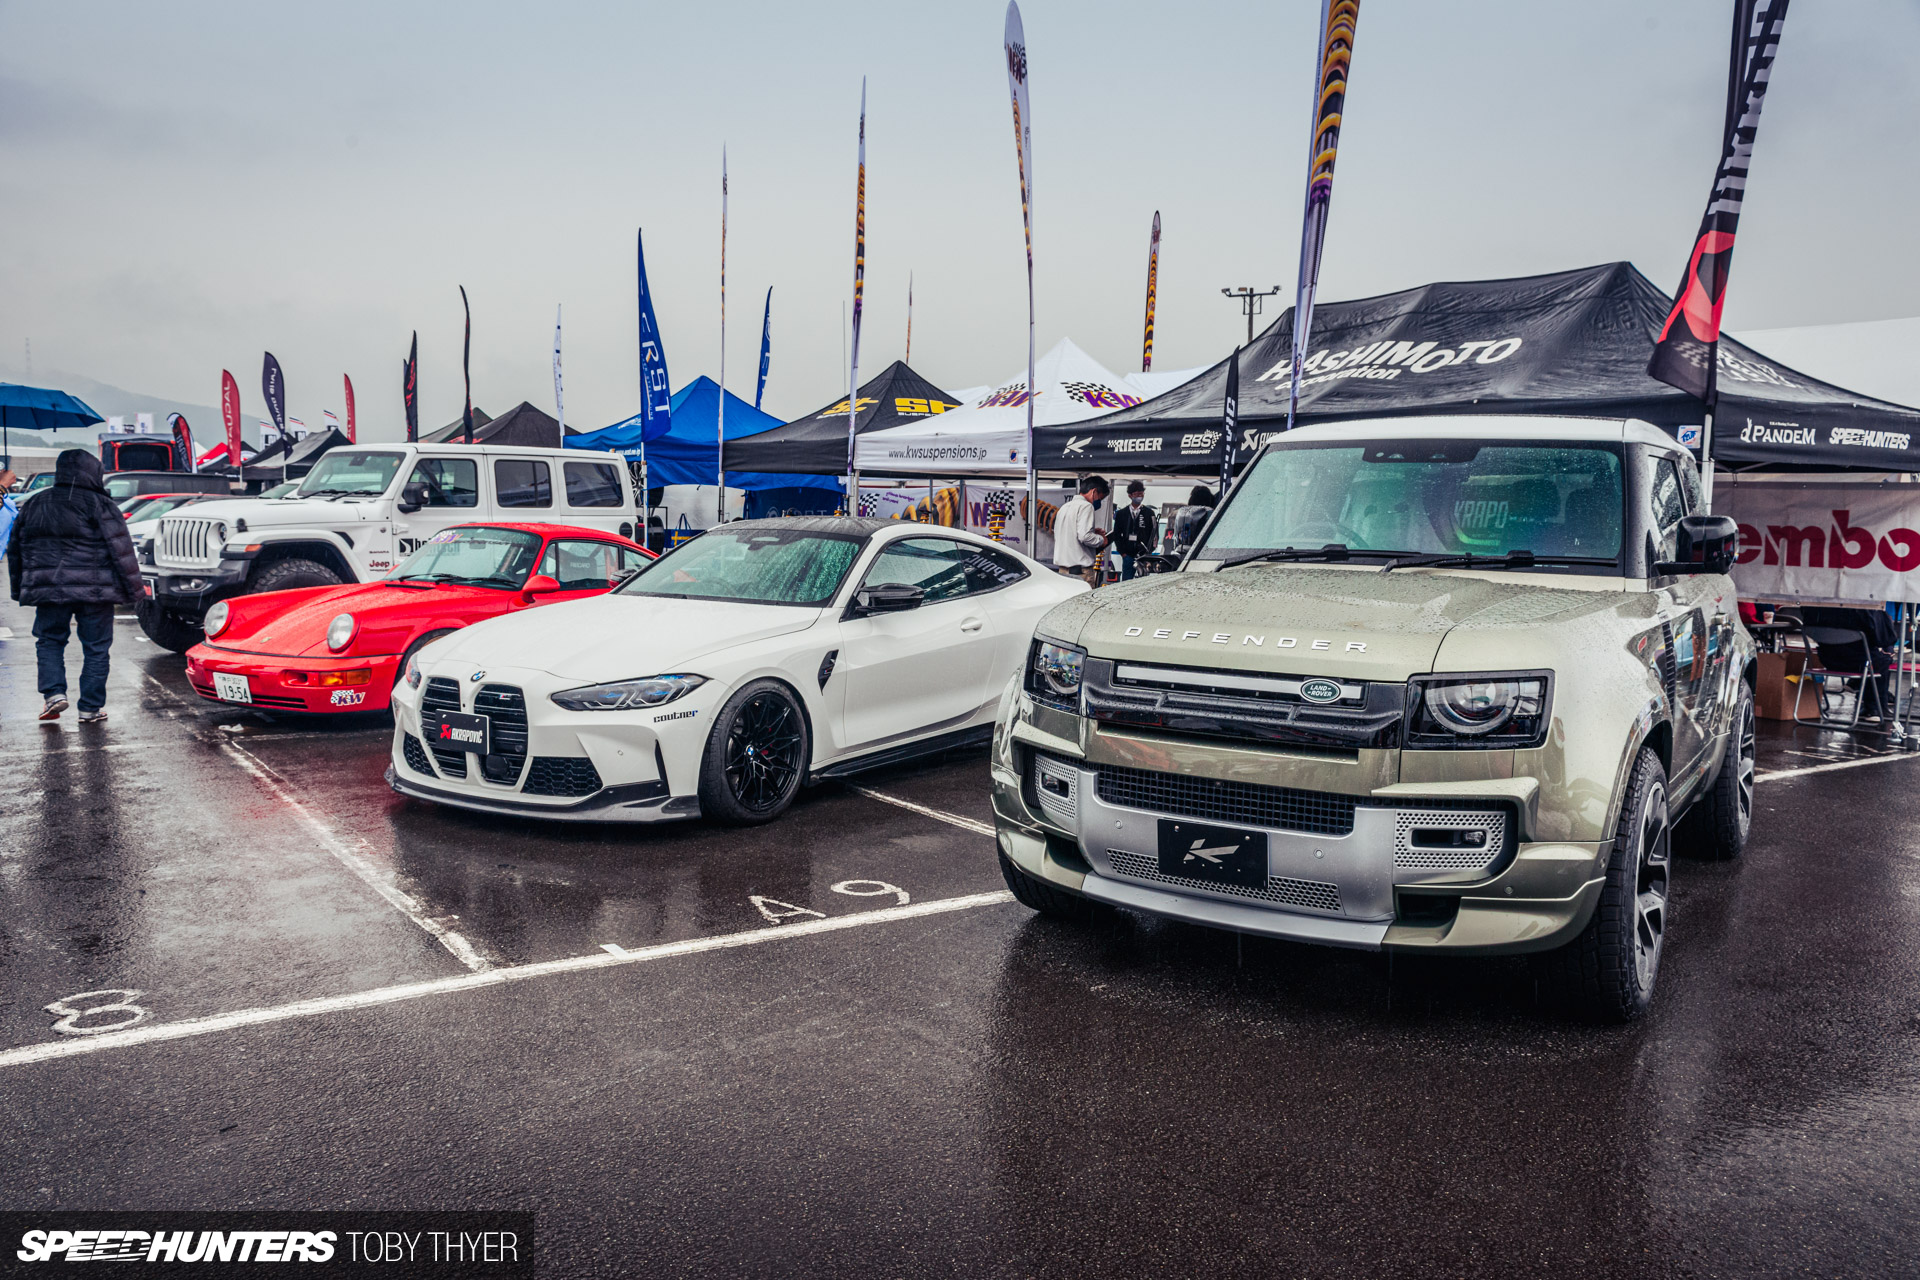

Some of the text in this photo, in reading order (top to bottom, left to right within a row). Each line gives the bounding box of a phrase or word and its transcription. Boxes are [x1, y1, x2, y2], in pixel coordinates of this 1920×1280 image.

[1255, 337, 1522, 382] HASHIMOTO
[1274, 364, 1402, 390] coporation
[1181, 434, 1213, 449] BBS
[1752, 425, 1816, 445] PANDEM
[1829, 427, 1911, 450] SPEEDHUNTERS
[1114, 437, 1162, 452] RIEGER
[888, 445, 987, 461] www.kwsuspensions.jp
[369, 559, 390, 568] Jeep
[1124, 626, 1369, 653] DEFENDER
[336, 692, 365, 706] KW
[653, 709, 699, 723] coutner
